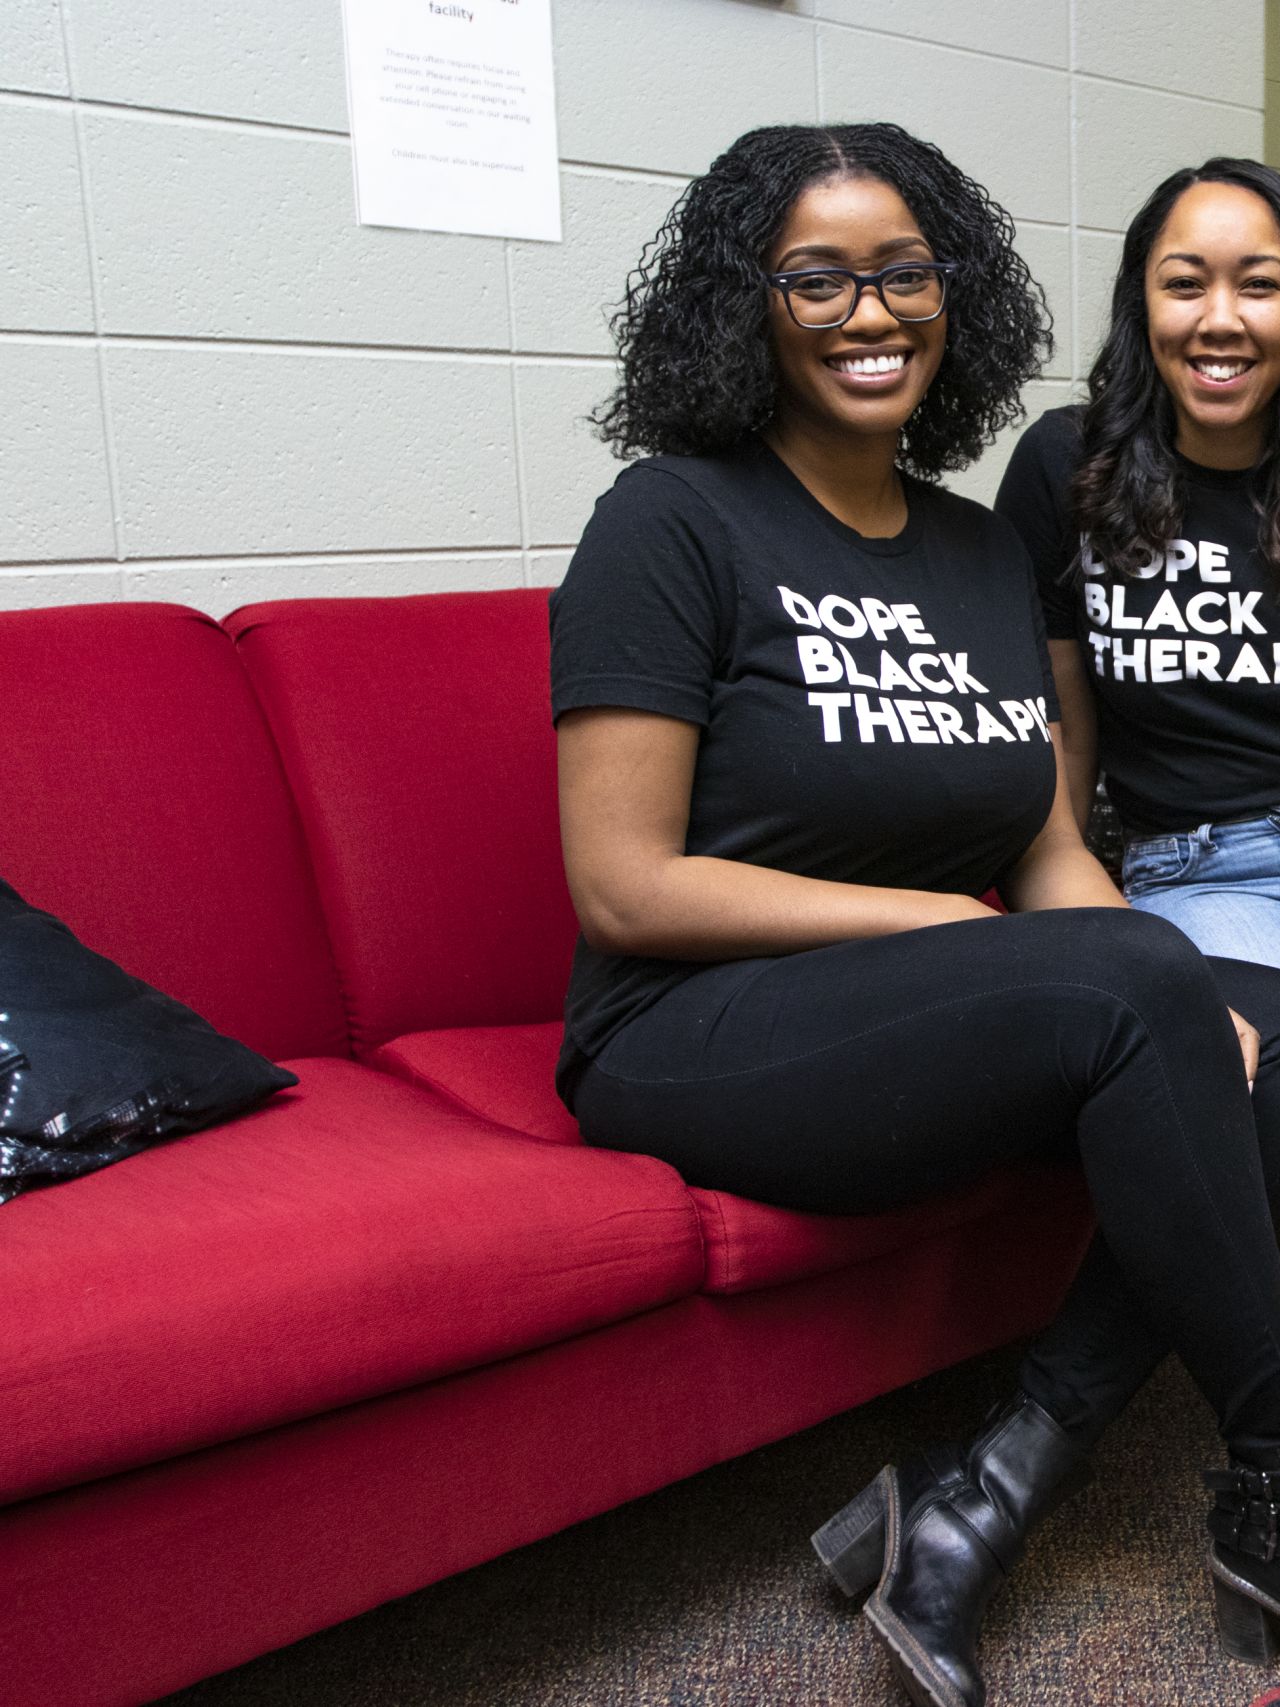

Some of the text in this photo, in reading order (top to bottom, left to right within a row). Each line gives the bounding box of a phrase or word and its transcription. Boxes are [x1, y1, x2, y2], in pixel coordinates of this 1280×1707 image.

[429, 2, 474, 22] facility
[386, 48, 420, 62] Therapy
[422, 54, 445, 65] often
[448, 59, 481, 72] requires
[506, 69, 520, 77] and
[426, 71, 452, 82] Please
[454, 75, 482, 86] refrain
[484, 79, 504, 89] from
[379, 95, 420, 107] extended
[422, 100, 475, 115] conversation
[487, 110, 502, 118] our
[503, 113, 531, 124] waiting
[415, 85, 430, 94] cell
[432, 87, 458, 99] phone
[471, 94, 507, 106] engaging
[391, 148, 427, 161] Children
[429, 154, 449, 164] must
[452, 157, 468, 166] also
[469, 159, 480, 167] be
[777, 586, 936, 644] DOPE
[1084, 582, 1268, 635] BLACK
[797, 635, 989, 693] BLACK
